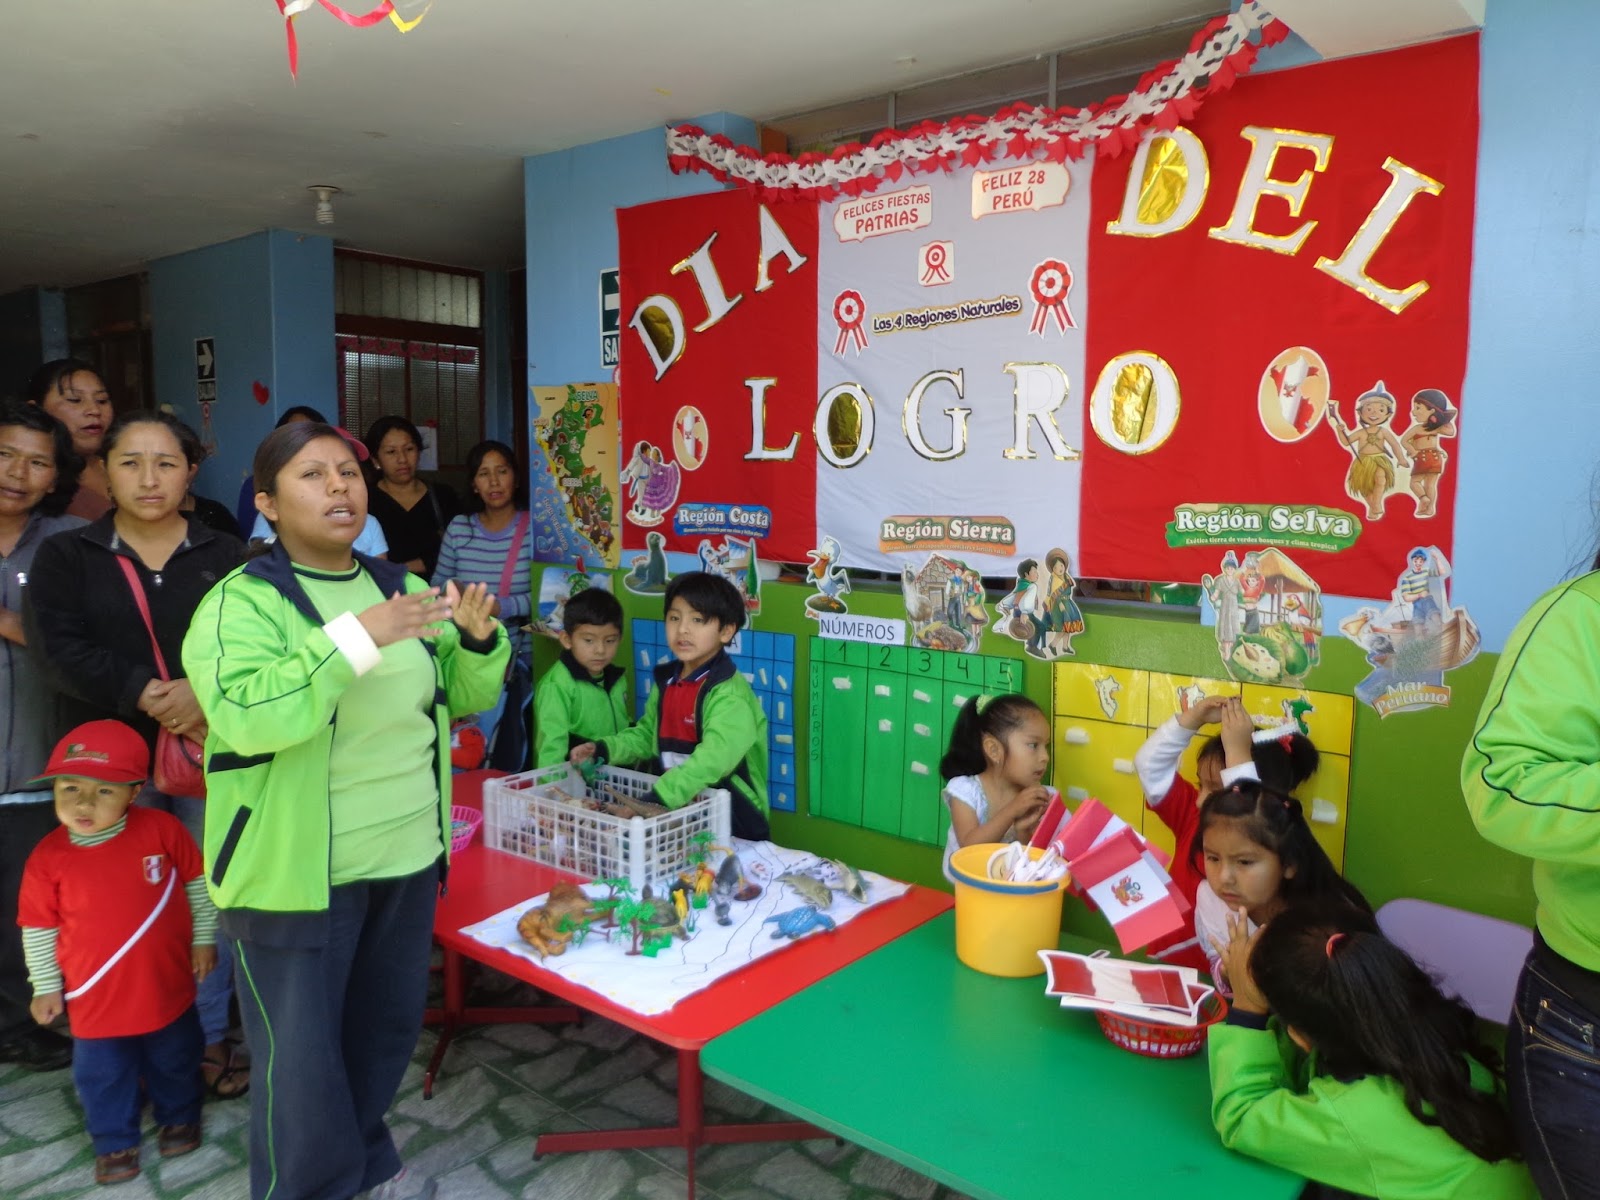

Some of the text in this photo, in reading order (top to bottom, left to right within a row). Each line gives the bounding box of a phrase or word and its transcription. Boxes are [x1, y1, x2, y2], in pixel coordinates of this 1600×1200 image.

[981, 170, 1046, 193] FELIZ 28
[843, 192, 931, 220] FELICES FIESTAS
[992, 187, 1034, 210] PERÚ
[855, 208, 919, 234] PATRIAS
[1106, 125, 1445, 315] DEL
[873, 297, 1019, 331] Las 4 Regiones Naturales
[604, 337, 620, 363] SA
[743, 350, 1182, 470] LOGRO
[679, 507, 769, 527] Región Costa
[883, 519, 1012, 541] Región Sierra
[1177, 507, 1351, 536] Región Selva
[820, 616, 895, 641] NÚMEROS
[838, 641, 1012, 684] 1 2 3 4 5
[1386, 681, 1426, 697] Mar
[1375, 692, 1448, 714] Peruano
